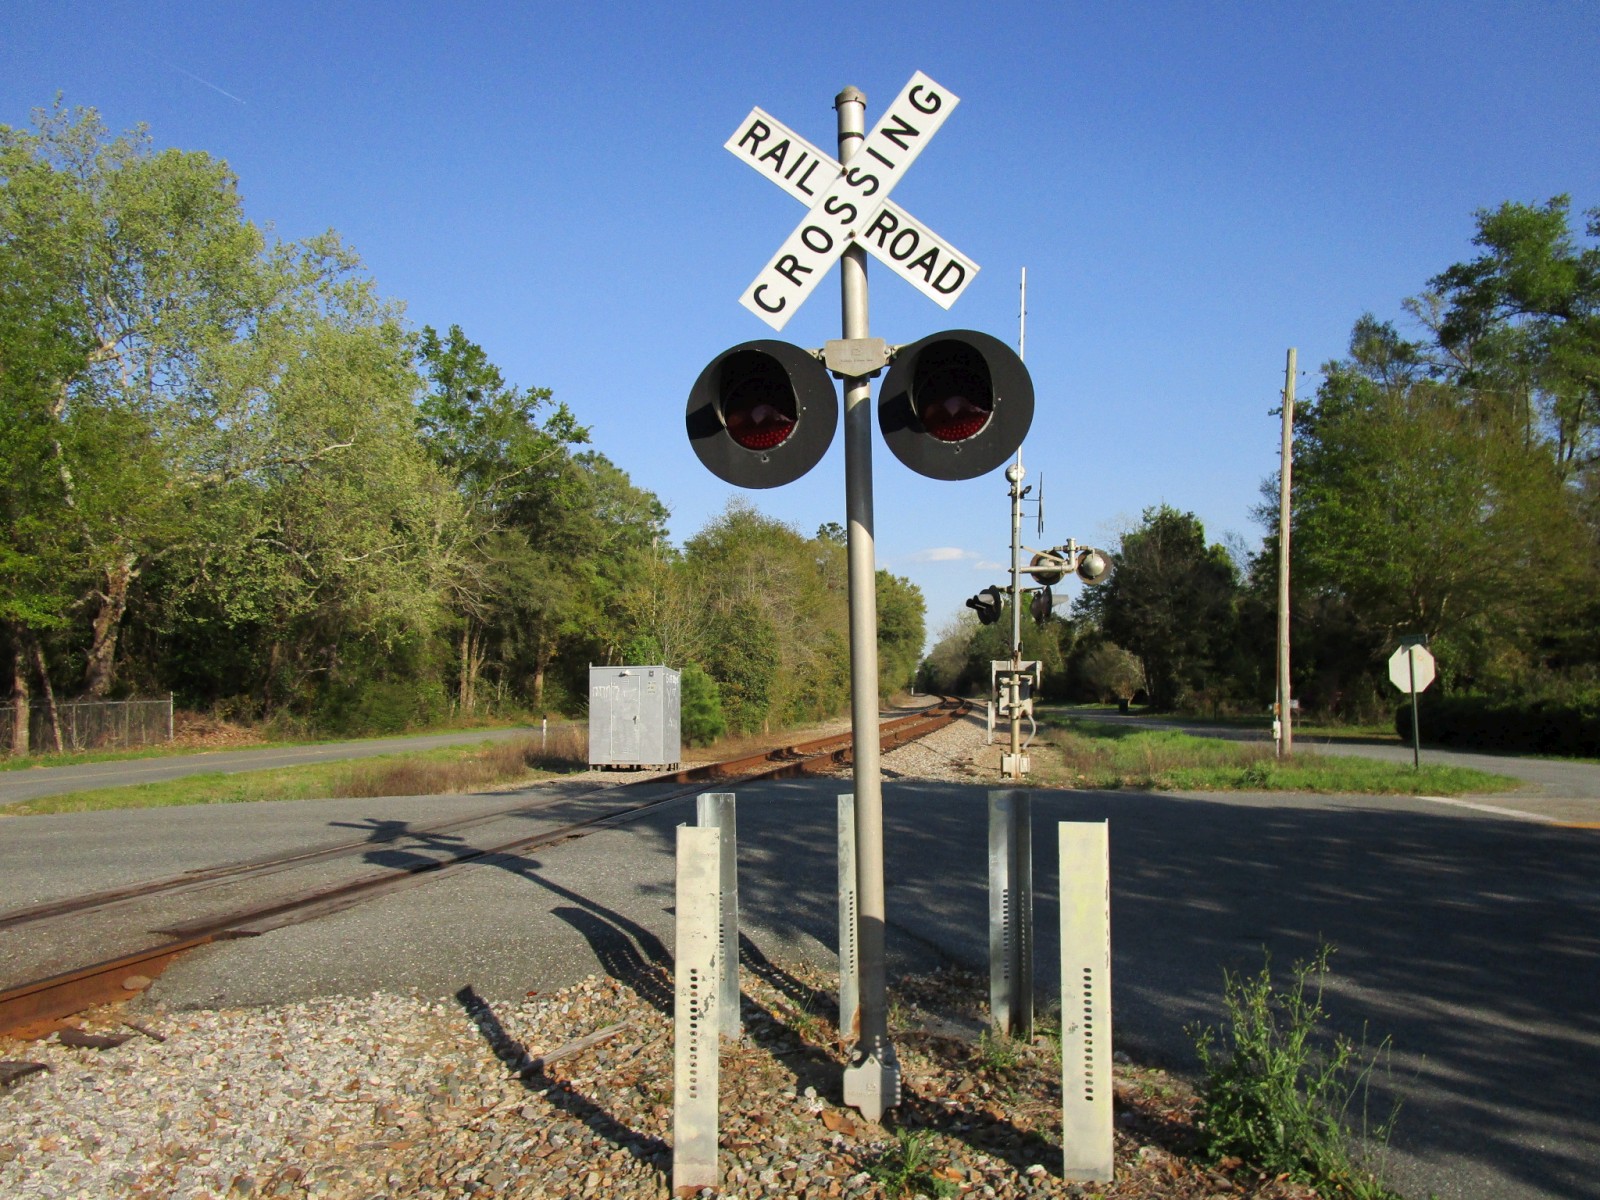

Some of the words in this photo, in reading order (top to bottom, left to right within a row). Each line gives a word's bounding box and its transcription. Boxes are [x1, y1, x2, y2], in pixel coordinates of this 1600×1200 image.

[738, 119, 820, 197] RAIL
[864, 208, 966, 294] ROAD
[753, 84, 943, 314] CROSSING
